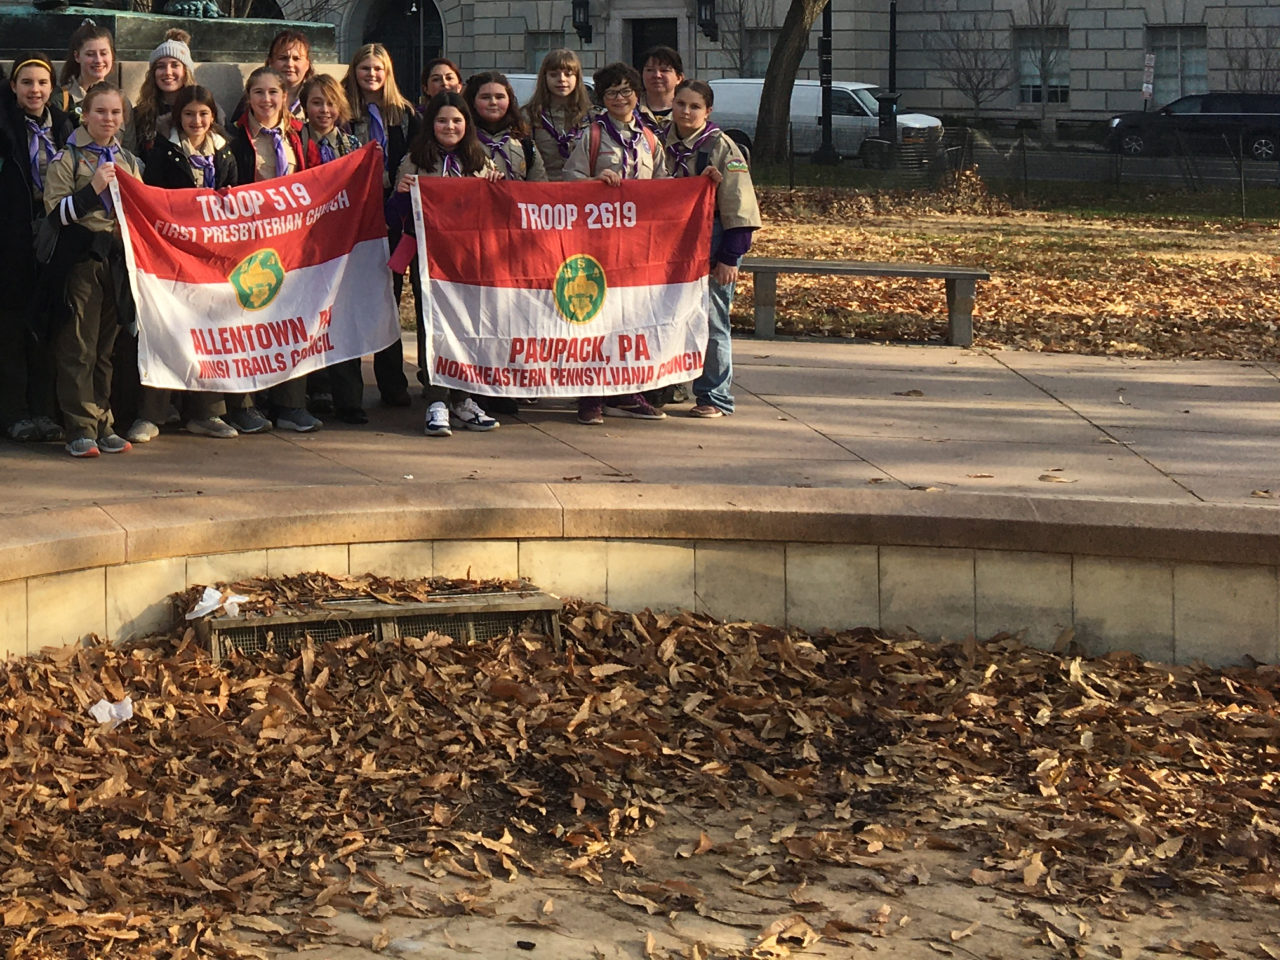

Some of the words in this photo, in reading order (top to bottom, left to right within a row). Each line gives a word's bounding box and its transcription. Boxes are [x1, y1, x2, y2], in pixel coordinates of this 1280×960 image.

[196, 190, 265, 222] TROOP
[267, 182, 312, 211] 519
[517, 202, 578, 230] TROOP
[584, 201, 637, 229] 2619
[154, 220, 197, 243] FIRST
[200, 212, 304, 244] PRESBYTERIAN
[319, 305, 333, 329] PA
[197, 360, 231, 379] MINSI
[232, 352, 288, 378] TRAILS
[291, 332, 335, 368] CONCIL
[509, 335, 610, 365] PAUPACK,
[618, 334, 651, 361] PA
[435, 355, 547, 388] NORTHEASTERN
[550, 365, 655, 387] PENNSYLVANIA
[657, 351, 704, 380] COUNCIL
